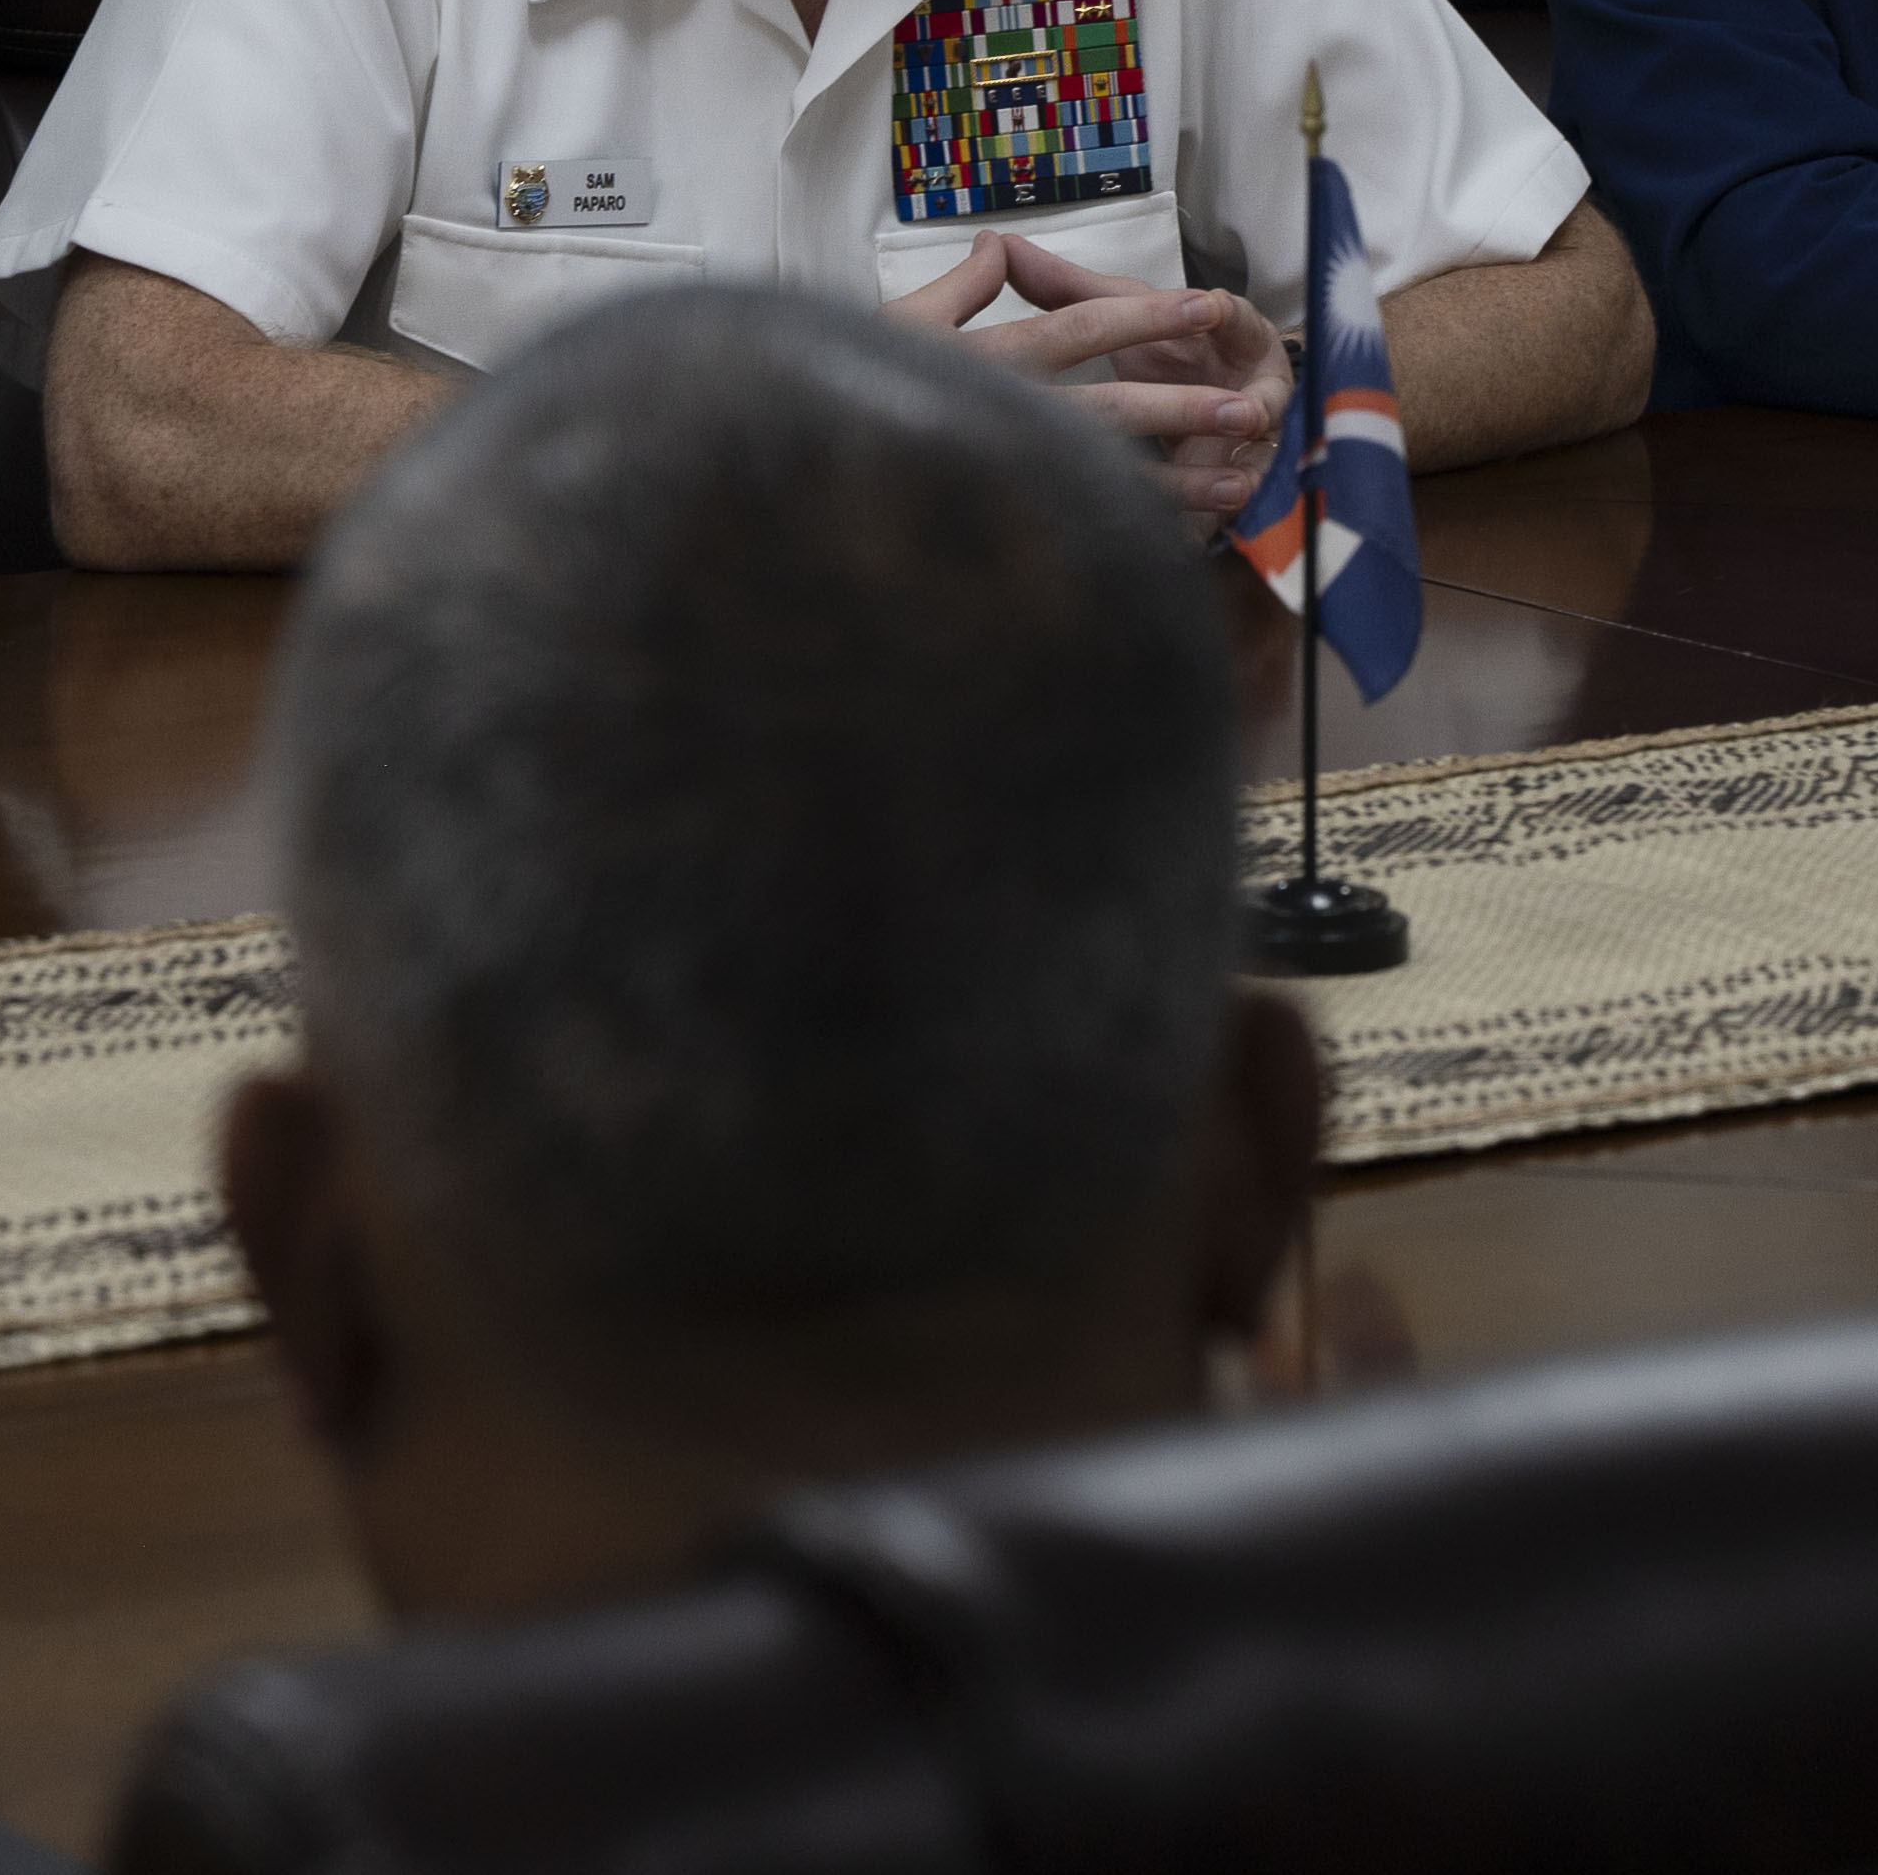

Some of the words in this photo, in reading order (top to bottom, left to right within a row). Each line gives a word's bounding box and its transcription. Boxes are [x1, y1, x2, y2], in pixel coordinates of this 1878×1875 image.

[586, 173, 615, 189] SAM
[1014, 183, 1036, 203] E
[1099, 172, 1121, 192] E
[573, 195, 626, 212] PAPARO
